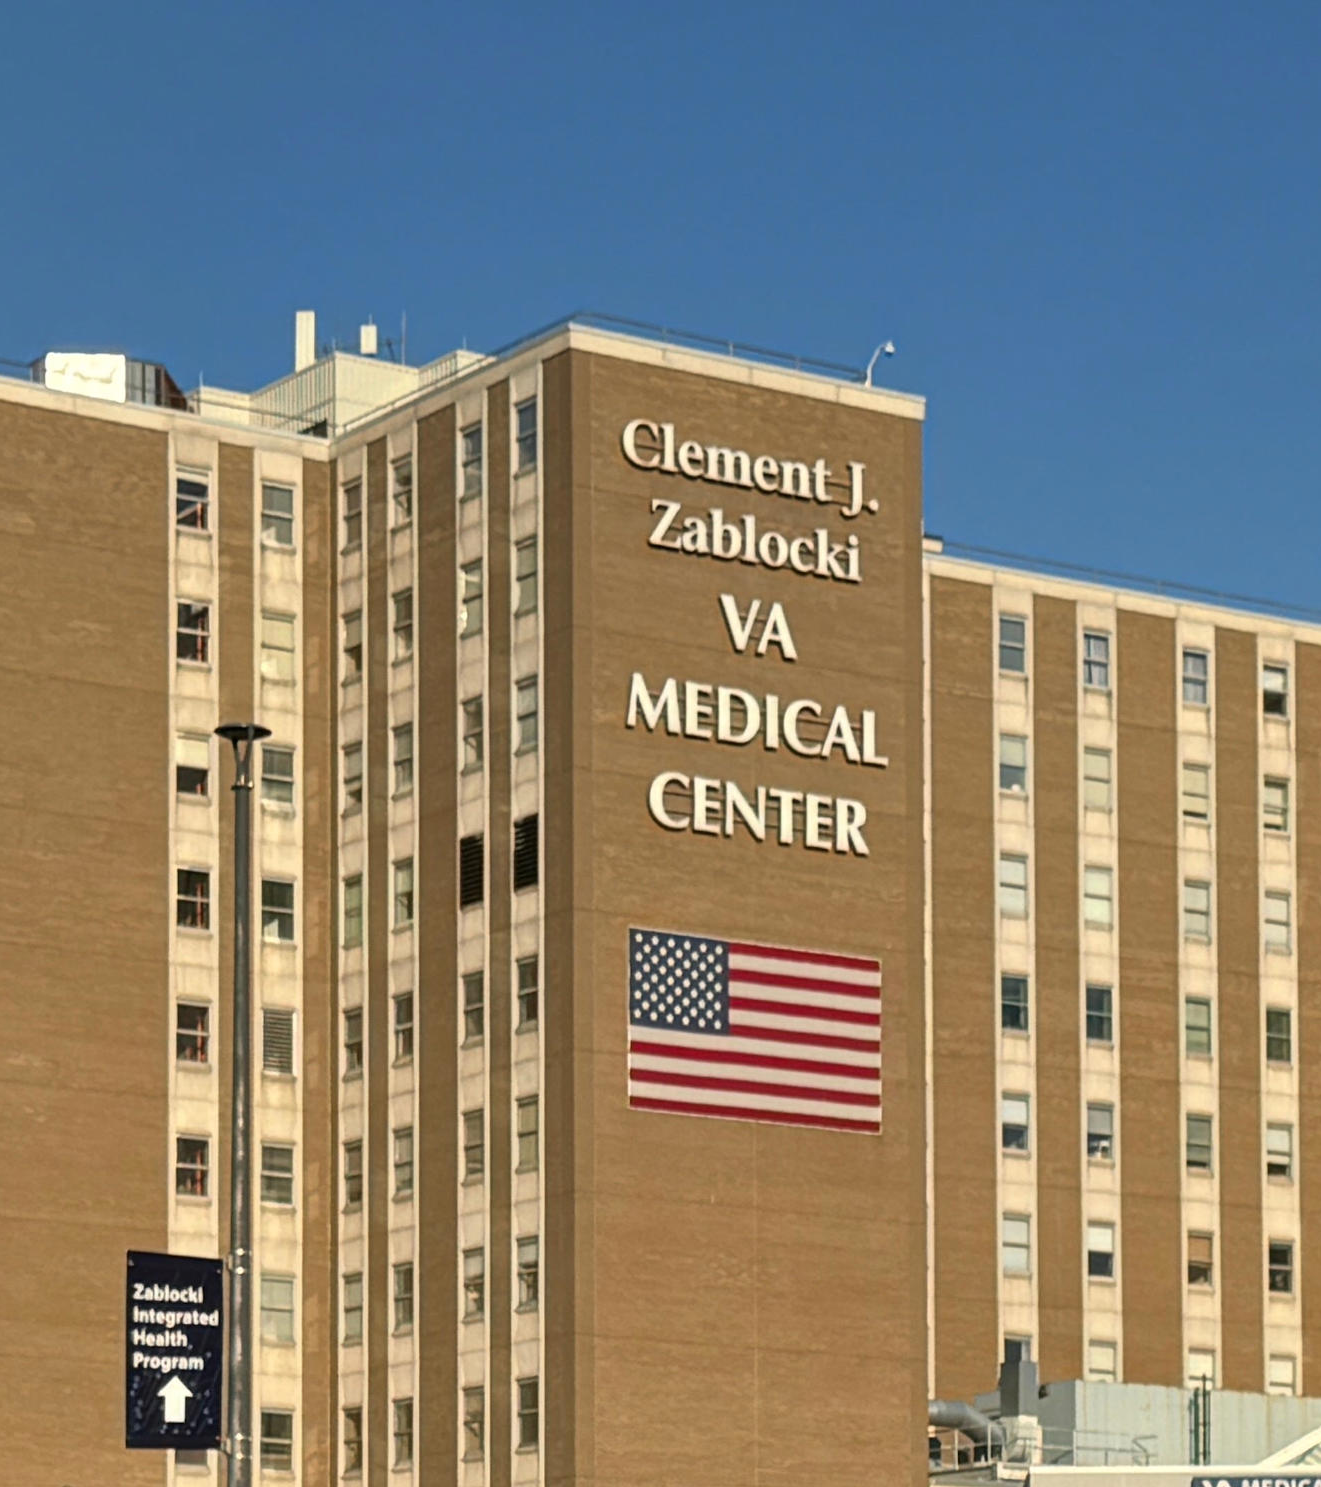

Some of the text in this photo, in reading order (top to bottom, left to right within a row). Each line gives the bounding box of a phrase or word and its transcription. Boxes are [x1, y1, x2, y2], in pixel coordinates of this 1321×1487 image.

[621, 419, 879, 517] Clement J.
[648, 498, 862, 582] Zablocki
[720, 593, 798, 660] VA
[625, 672, 889, 766] MEDICAL
[649, 771, 869, 856] CENTER
[133, 1283, 204, 1303] Zablocki
[133, 1305, 219, 1328] Integrated
[133, 1328, 188, 1347] Health
[133, 1351, 205, 1373] Program
